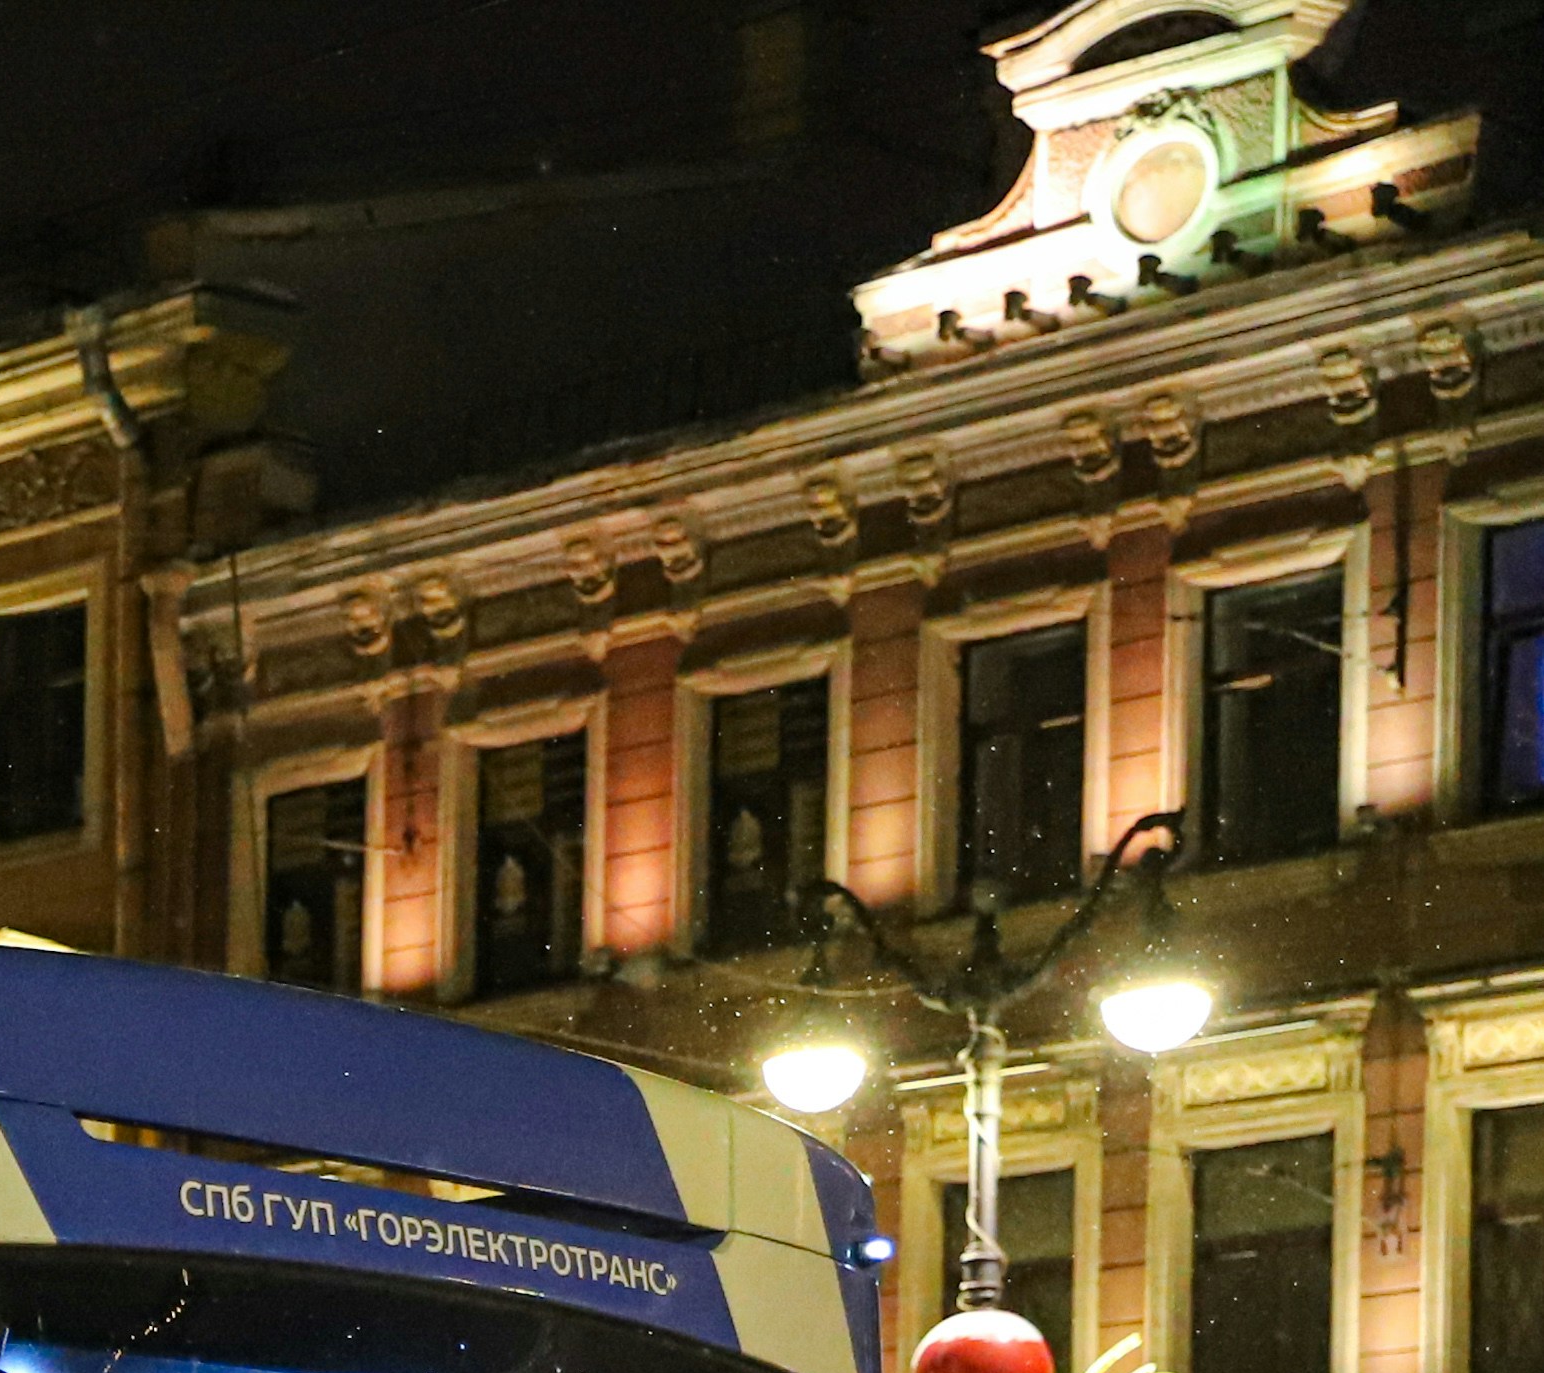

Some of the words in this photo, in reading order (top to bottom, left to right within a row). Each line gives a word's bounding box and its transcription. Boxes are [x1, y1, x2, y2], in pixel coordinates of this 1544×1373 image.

[179, 1180, 255, 1223] СПб
[262, 1192, 337, 1236] ГУП
[344, 1208, 678, 1296] «ГОРЭЛЕКТРОТРАНС»
